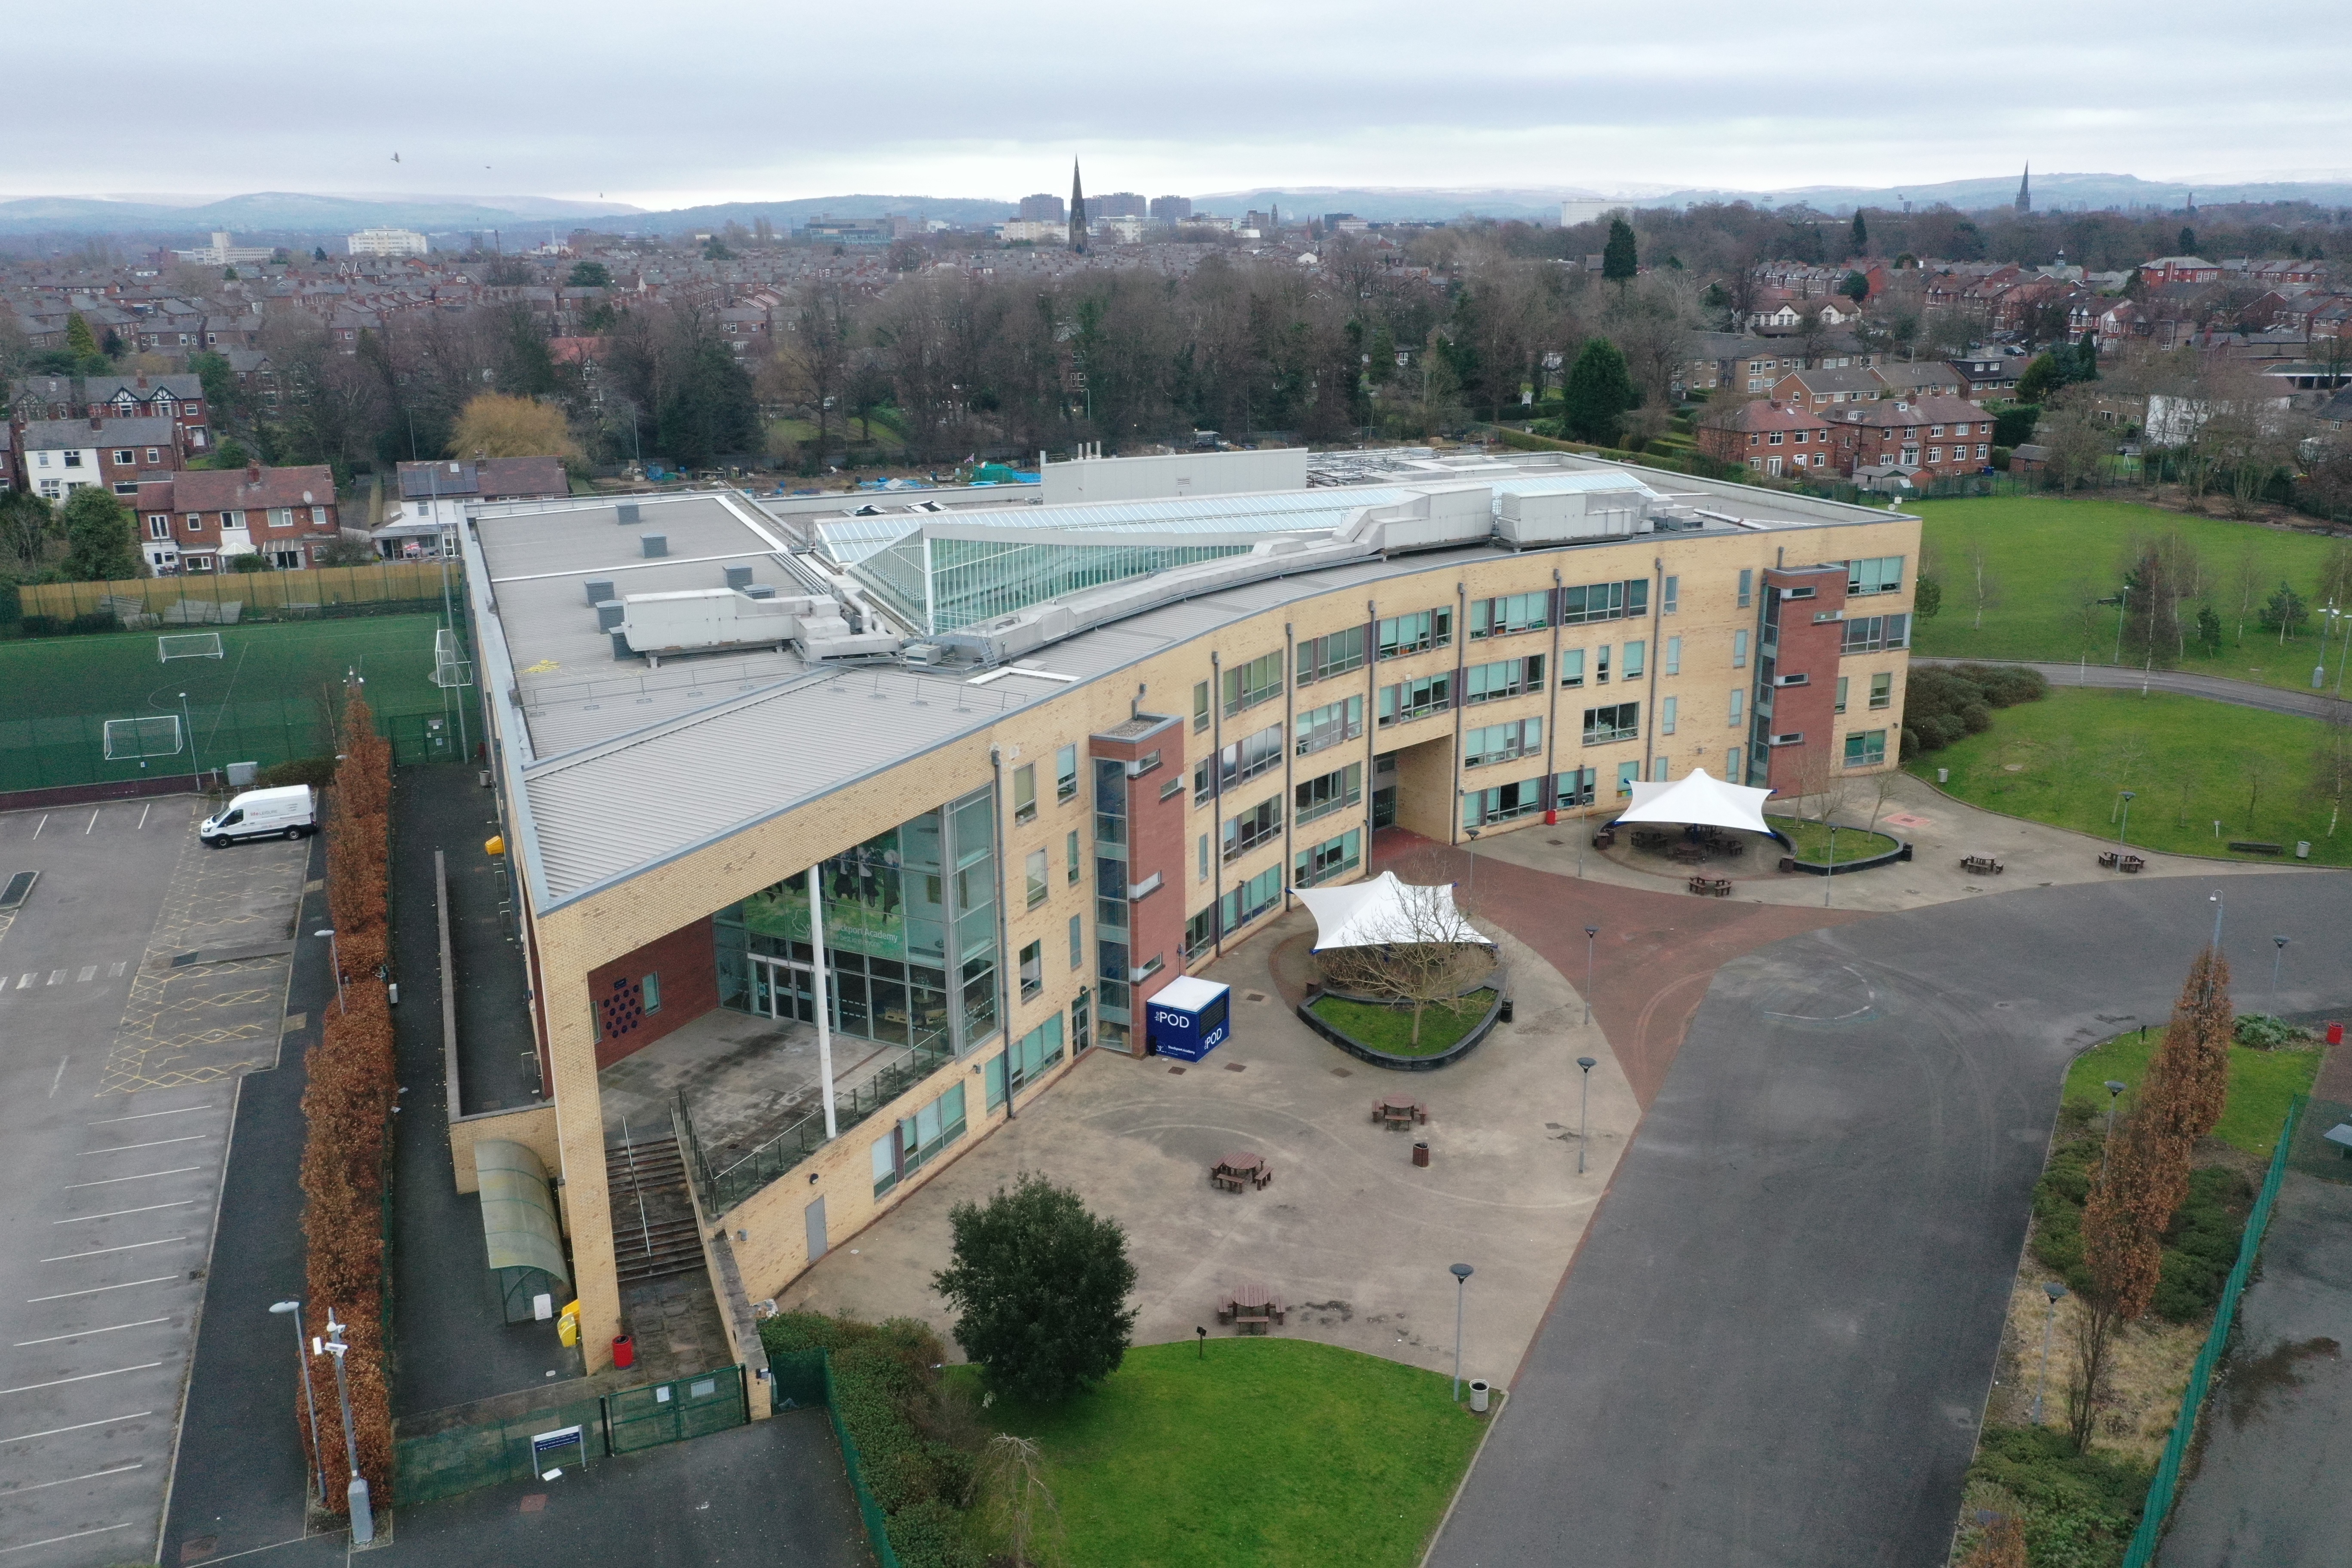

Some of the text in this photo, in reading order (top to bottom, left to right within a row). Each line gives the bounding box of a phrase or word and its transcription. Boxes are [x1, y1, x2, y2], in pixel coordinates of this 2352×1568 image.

[829, 921, 898, 943] Sockport Academy
[840, 934, 851, 942] best
[858, 938, 881, 948] eryone
[1160, 1011, 1189, 1028] POD
[1207, 1028, 1222, 1049] POD
